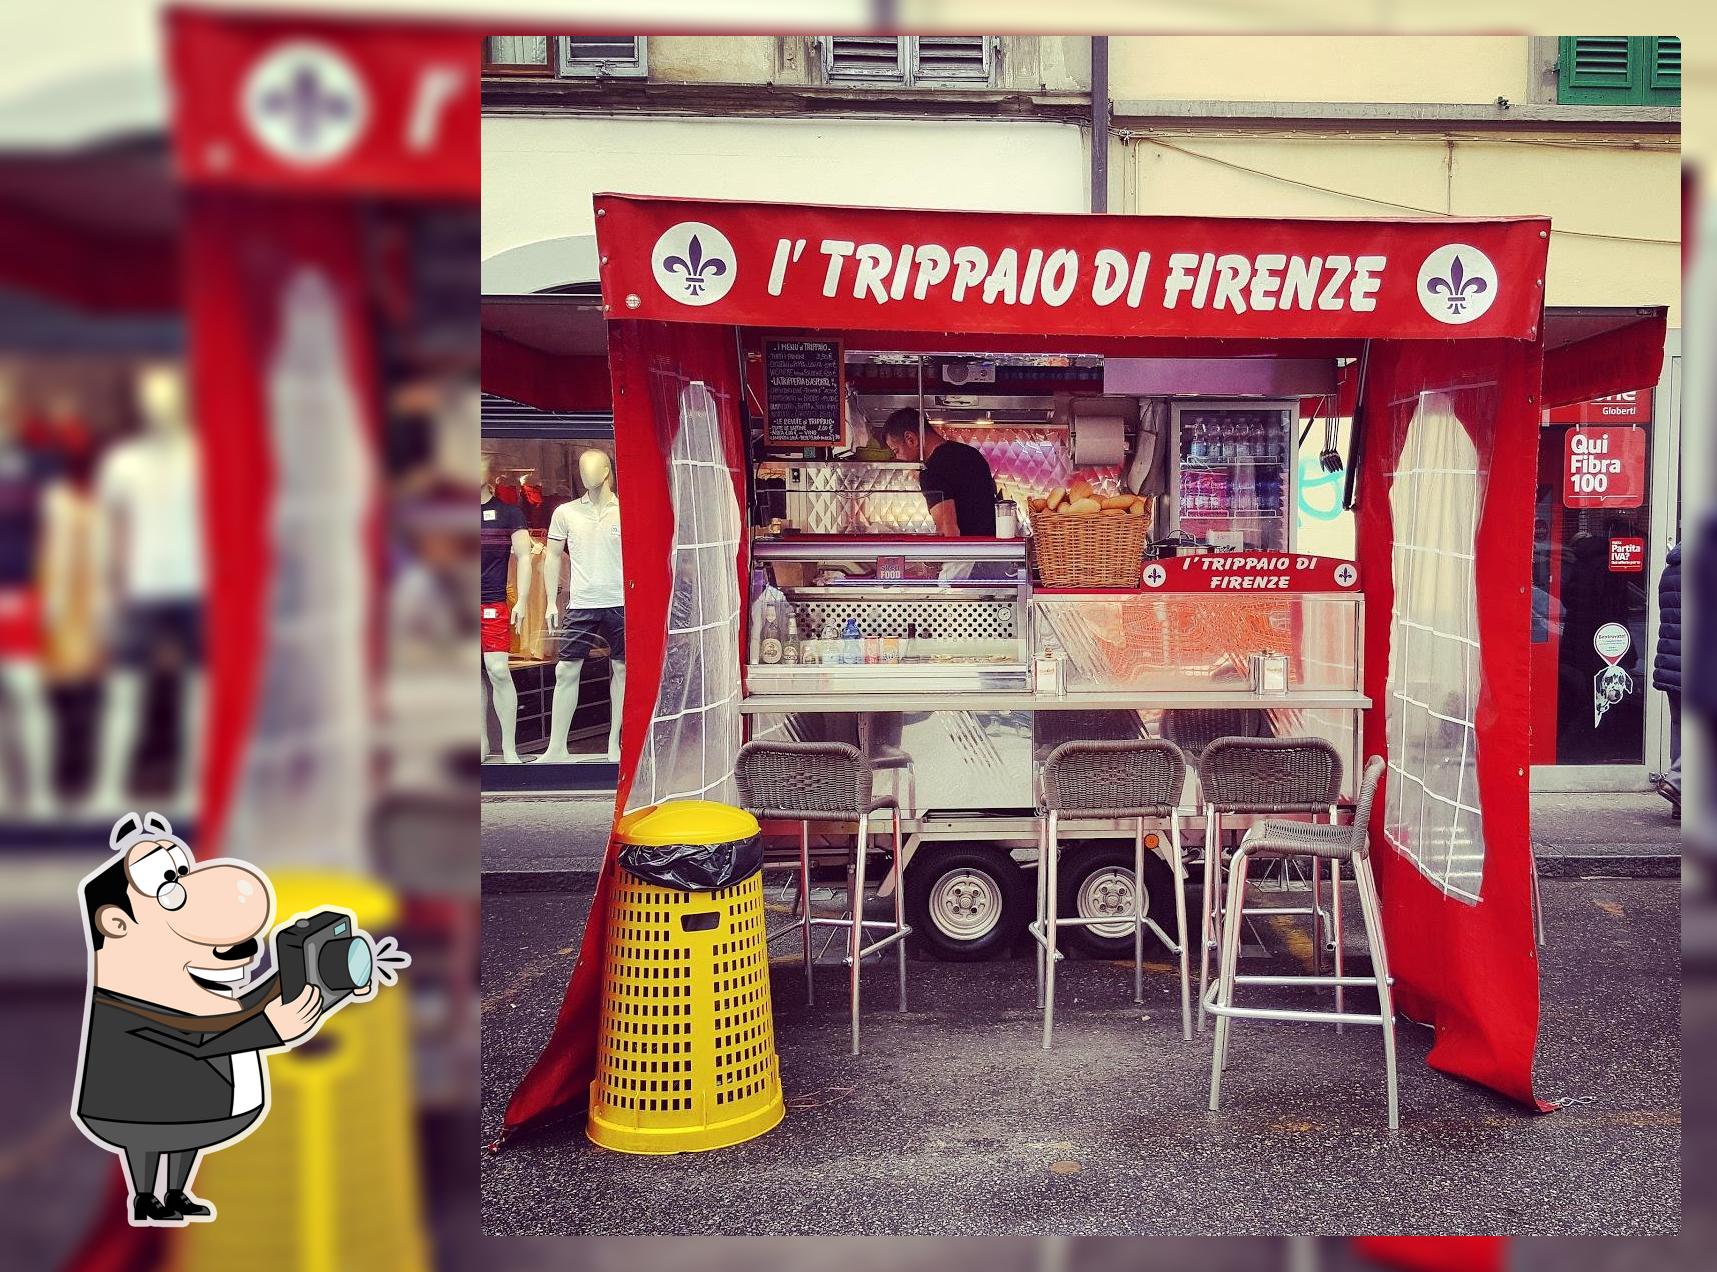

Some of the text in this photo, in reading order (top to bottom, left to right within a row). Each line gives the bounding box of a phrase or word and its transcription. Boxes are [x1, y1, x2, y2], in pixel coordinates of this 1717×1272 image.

[768, 239, 1387, 315] I' TRIPPAIO DI FIRENZE
[1571, 434, 1609, 454] Qui
[1571, 455, 1621, 474] Fibra
[1570, 473, 1608, 493] 100
[1611, 544, 1641, 553] Partita
[1611, 552, 1630, 561] IVA?
[1202, 557, 1290, 570] TRIPPAIO
[1296, 557, 1318, 570] DI
[880, 570, 900, 579] FOOD
[1210, 576, 1290, 589] FIRENZE
